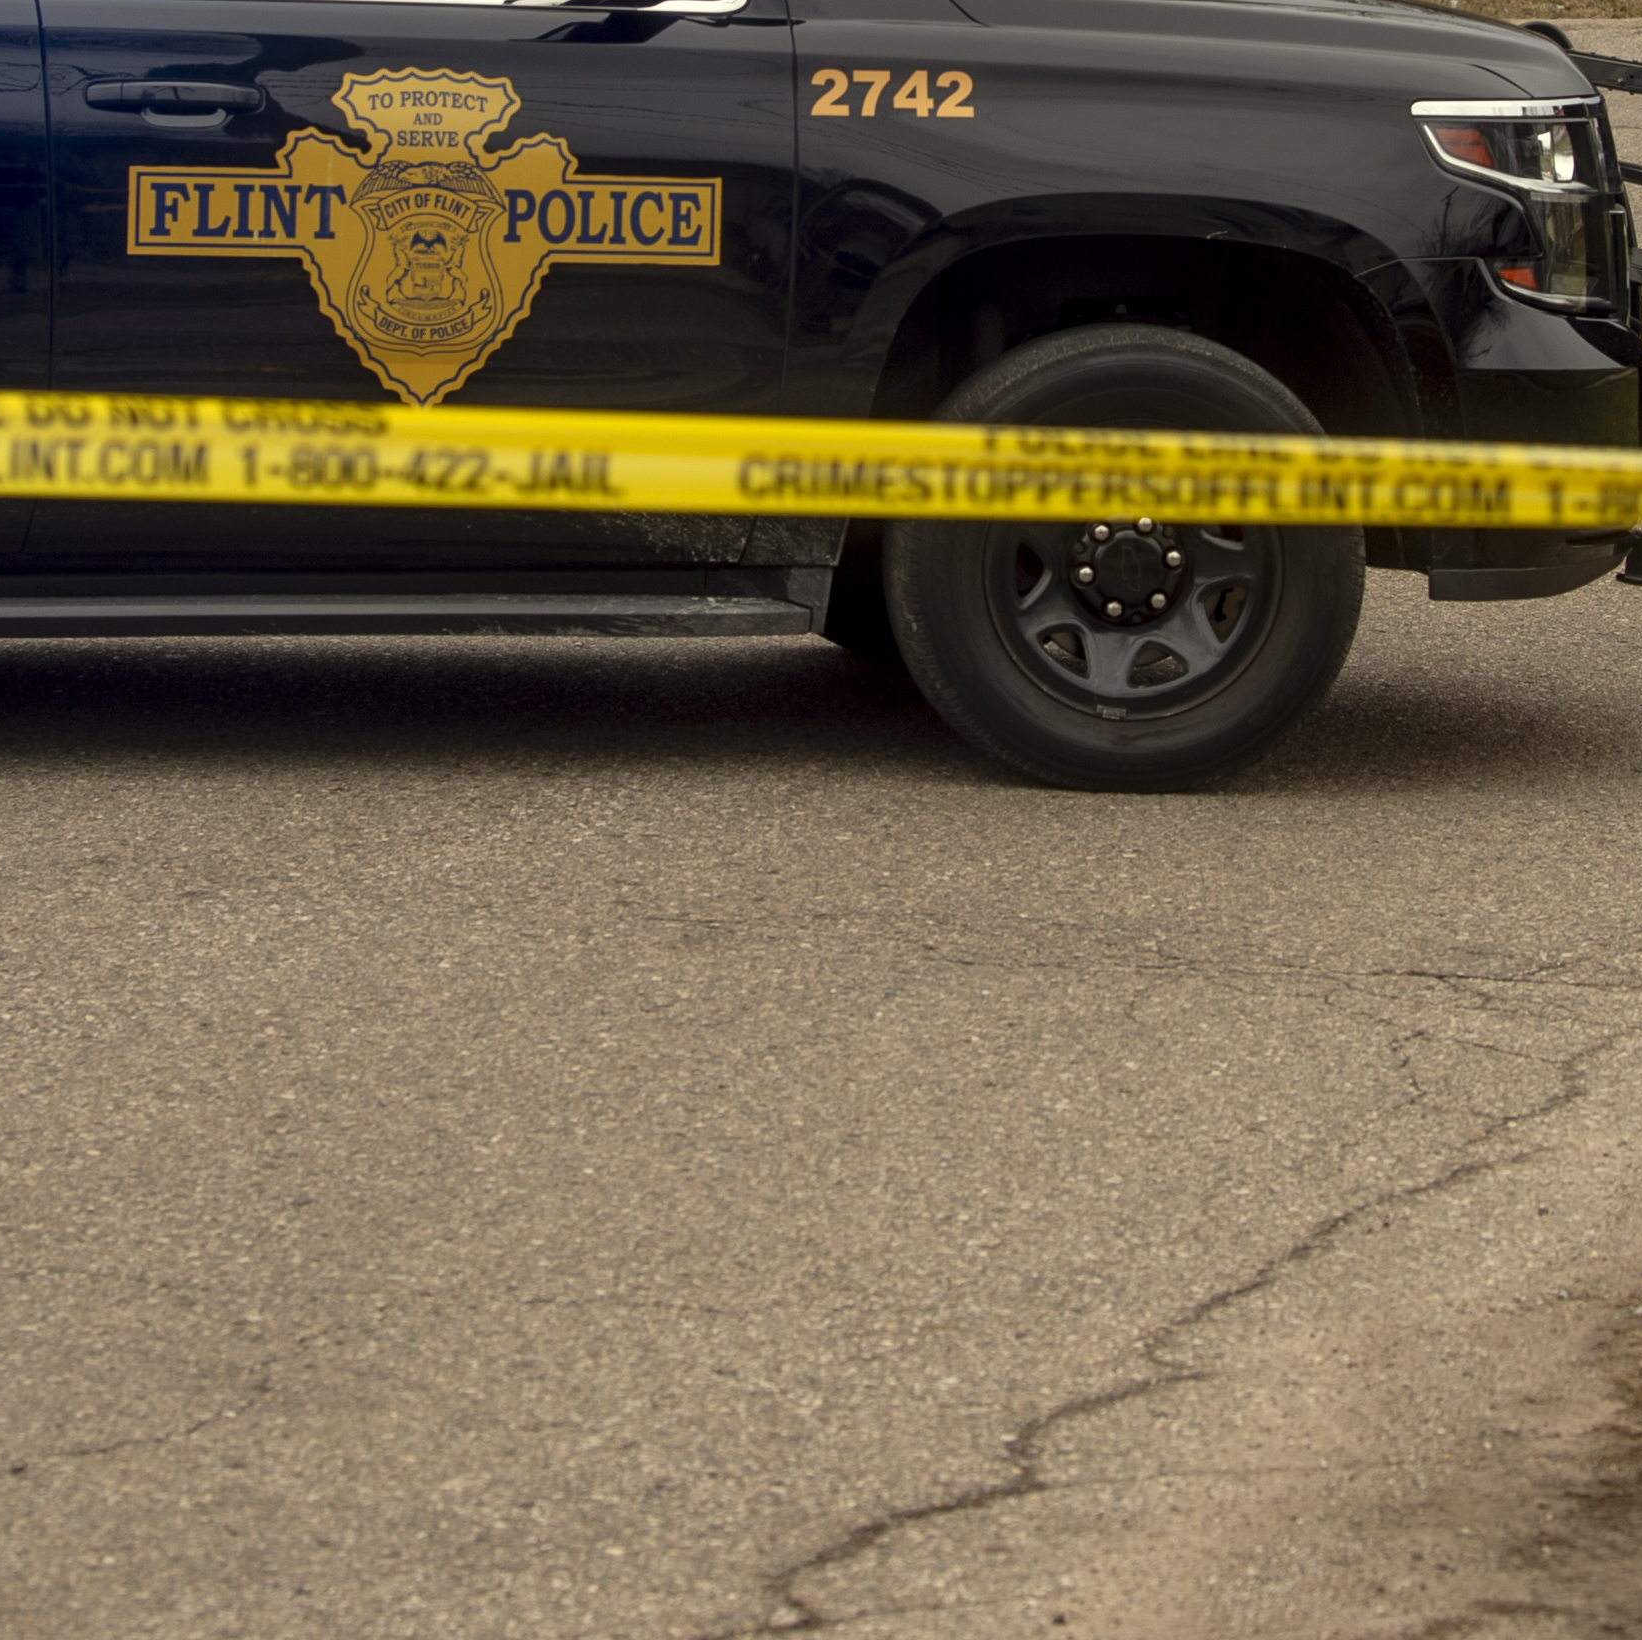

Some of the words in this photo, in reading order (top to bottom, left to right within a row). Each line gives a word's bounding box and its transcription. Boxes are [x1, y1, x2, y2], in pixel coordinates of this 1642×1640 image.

[368, 93, 394, 111] TO
[400, 91, 489, 113] PROTECT
[810, 68, 975, 118] 2742
[413, 113, 443, 126] AND
[397, 130, 460, 148] SERVE
[149, 182, 347, 240] FLINT
[502, 189, 703, 247] POLICE
[384, 195, 411, 219] CITY
[414, 193, 431, 209] OF
[434, 194, 471, 219] FLINT
[379, 316, 408, 337] DEPT.
[411, 327, 427, 339] OF
[430, 317, 469, 339] POLICE
[237, 443, 627, 498] 1-800-422-JAIL
